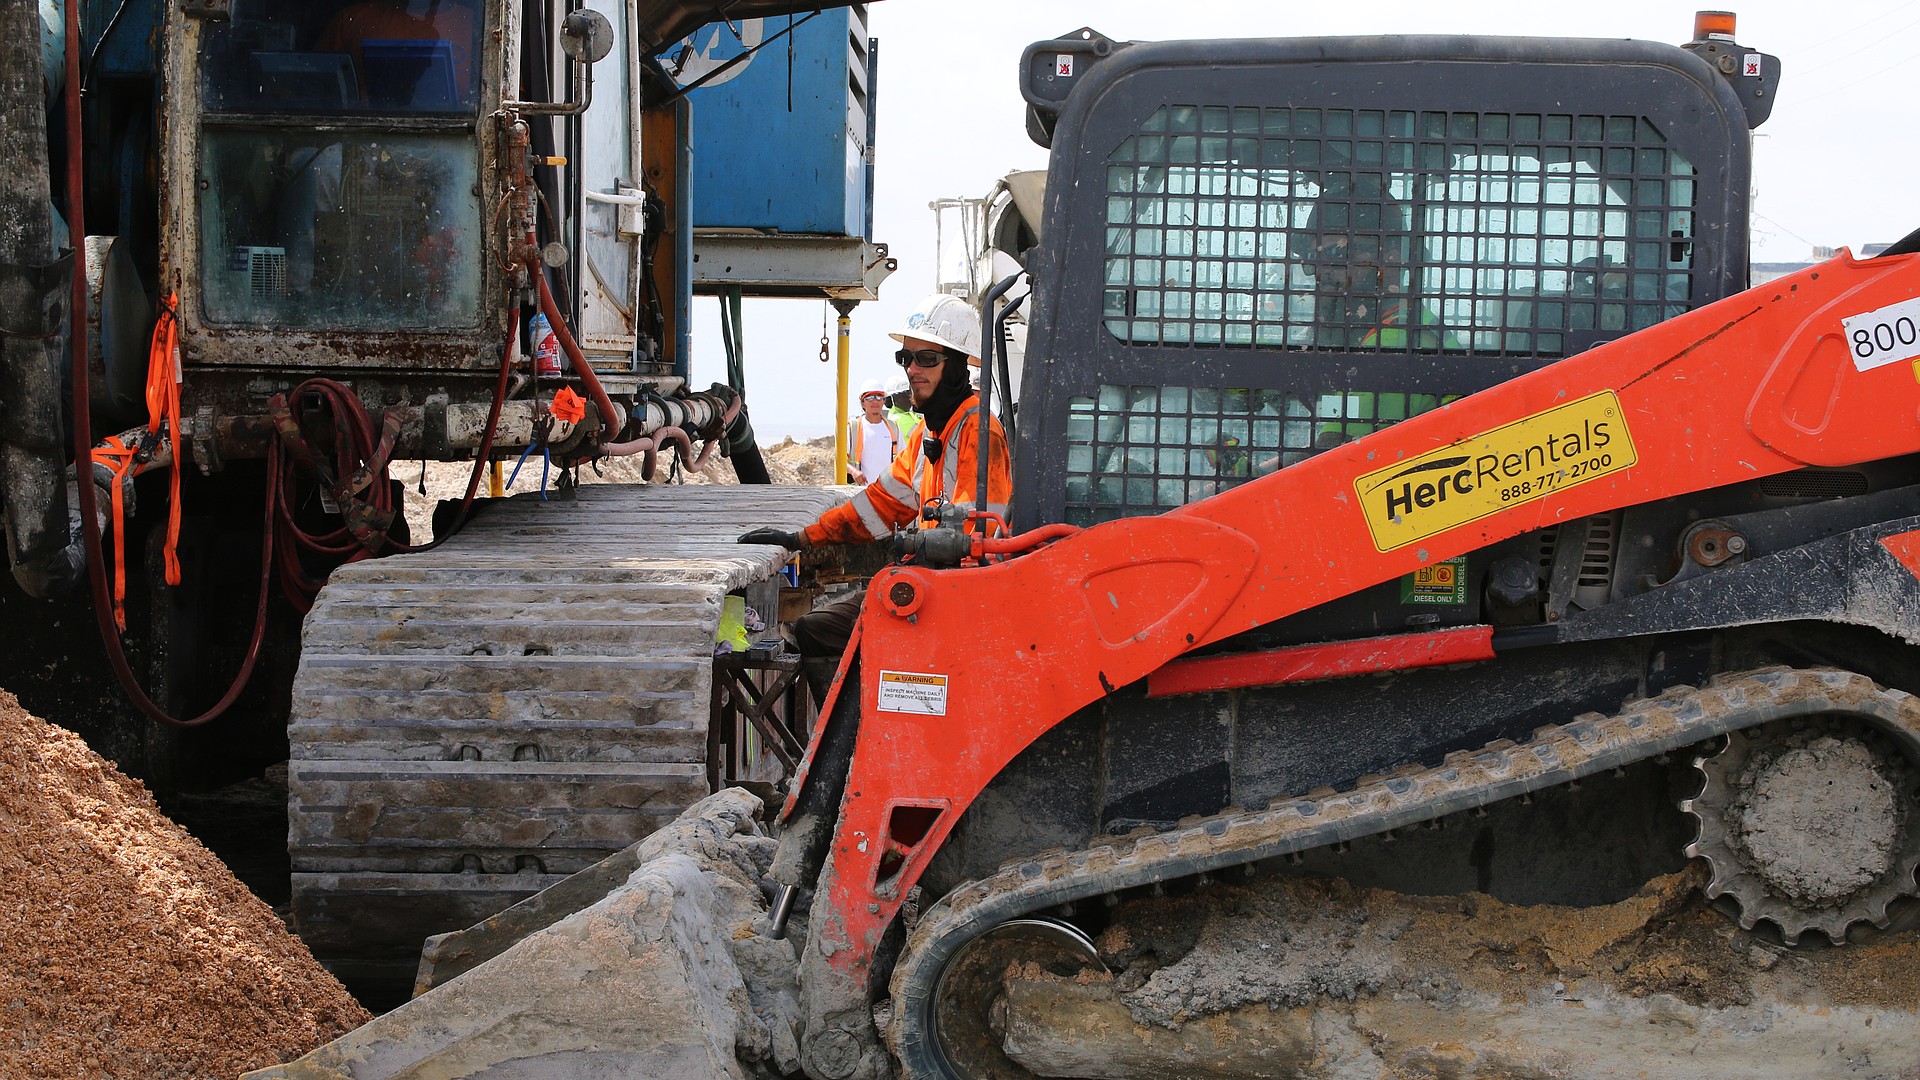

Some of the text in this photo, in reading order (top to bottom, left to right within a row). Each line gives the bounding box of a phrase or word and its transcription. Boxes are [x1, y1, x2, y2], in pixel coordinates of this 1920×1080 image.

[1853, 317, 1920, 358] 800
[1501, 454, 1612, 502] 888-777-2700
[902, 676, 934, 684] WARNING
